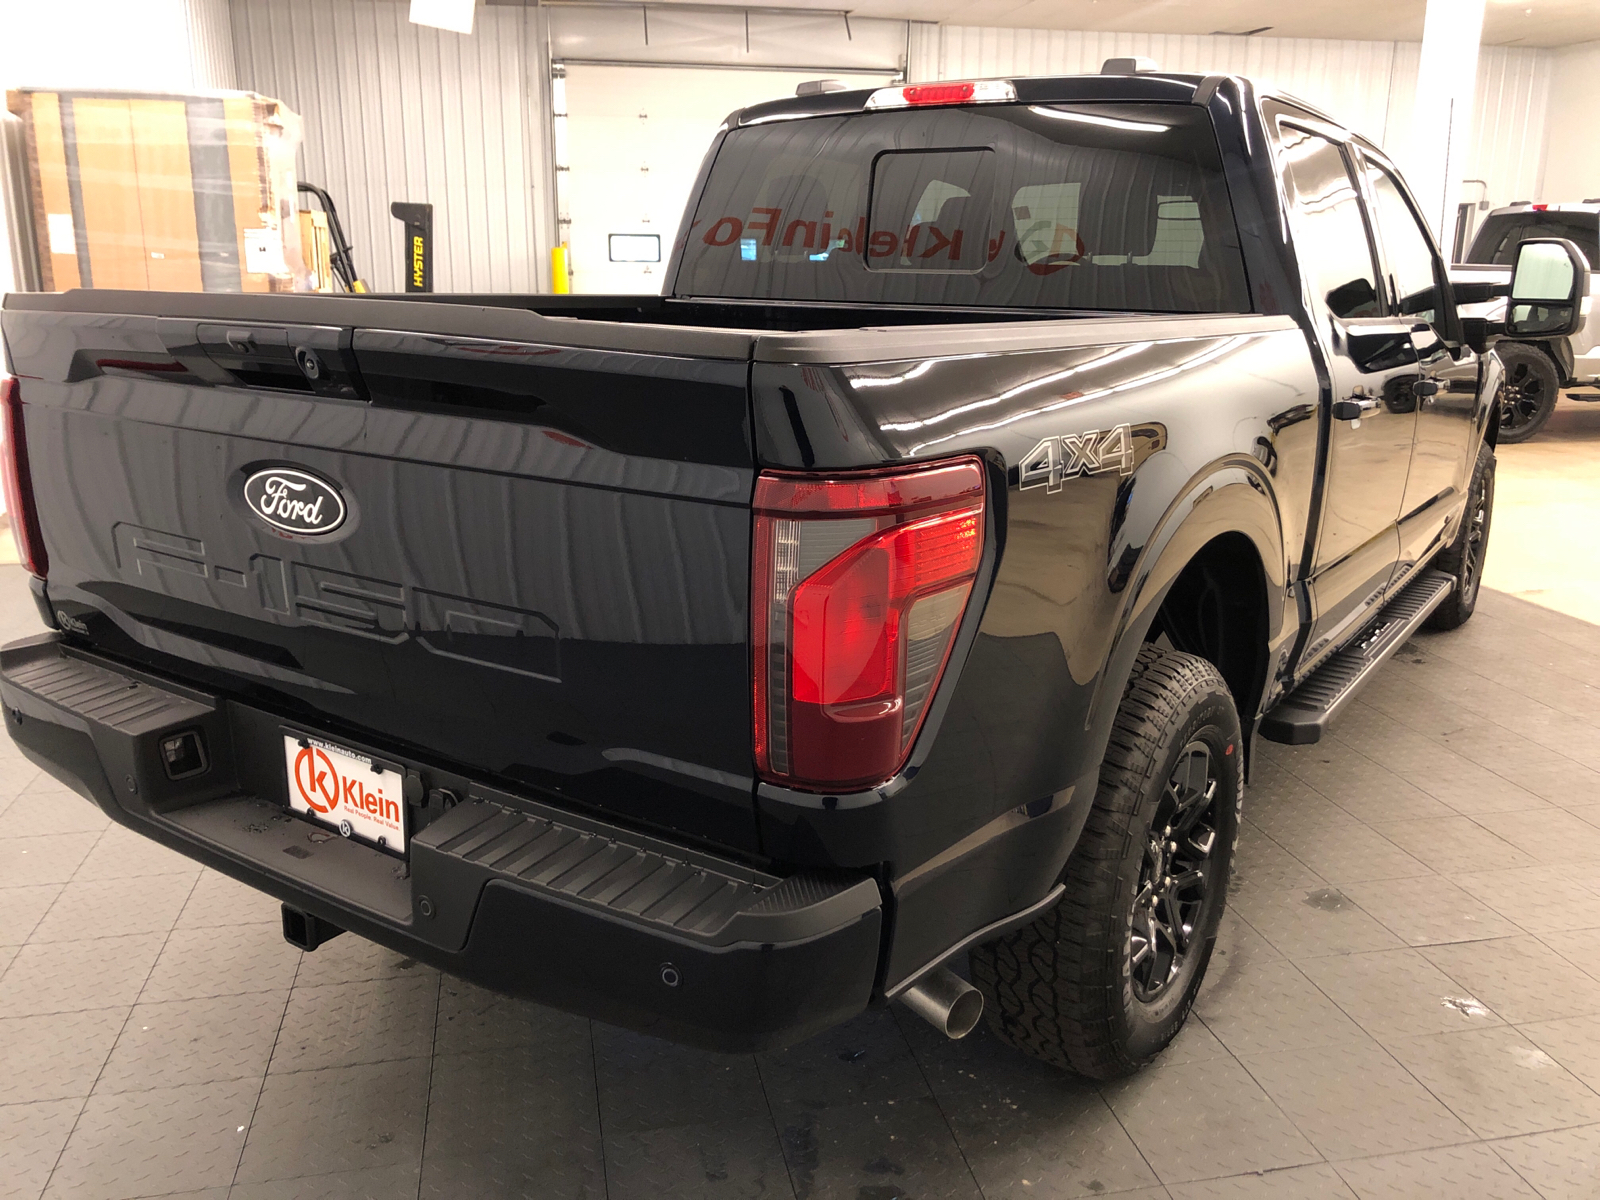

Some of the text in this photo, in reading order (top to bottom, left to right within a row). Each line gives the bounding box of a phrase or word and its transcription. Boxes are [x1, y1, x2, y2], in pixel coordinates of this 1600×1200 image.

[413, 236, 424, 287] HYSTER
[260, 476, 324, 525] Ford
[112, 521, 562, 684] F-150
[306, 737, 372, 764] www.kleinauto.com
[342, 776, 400, 823] Klein
[344, 805, 401, 832] Real People. Real Value.
